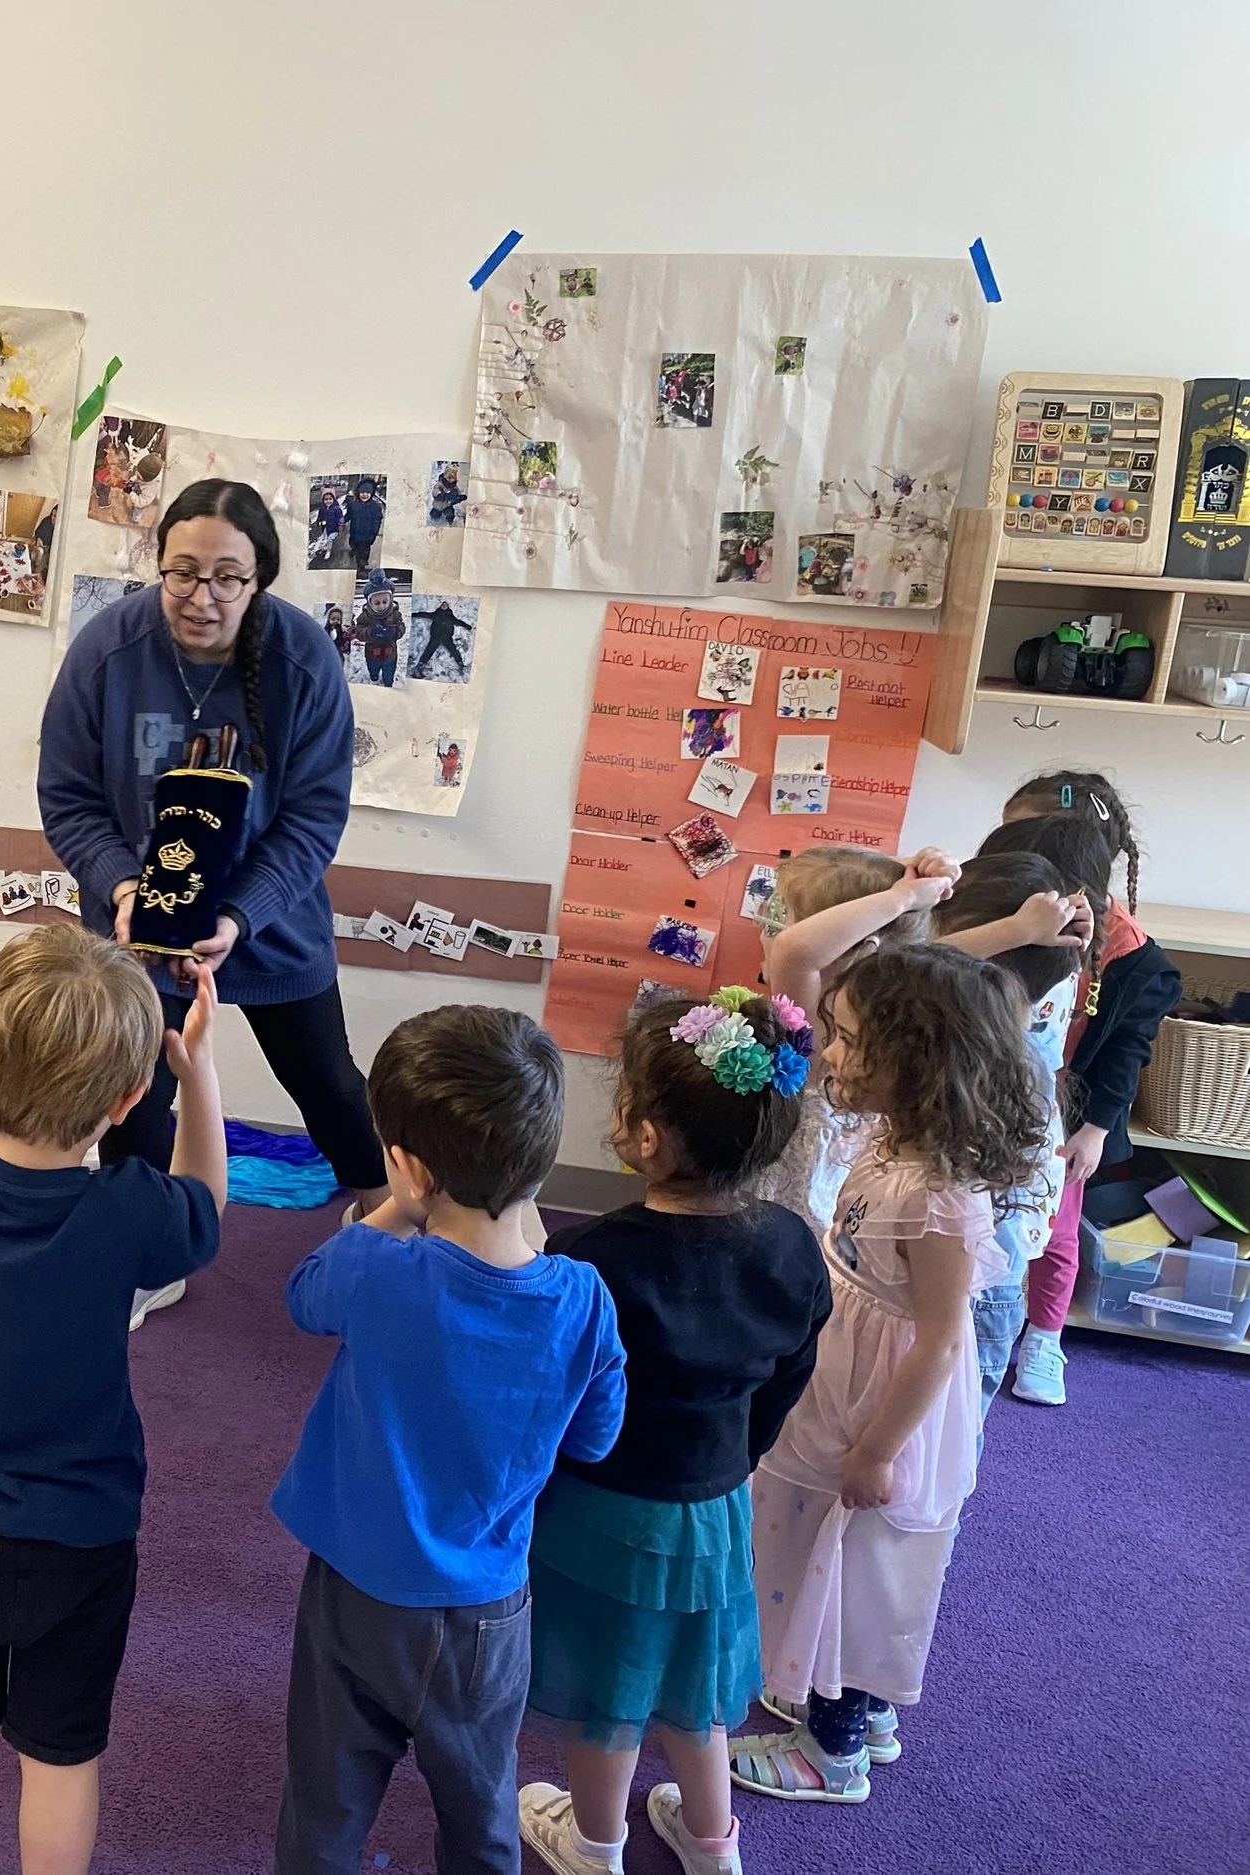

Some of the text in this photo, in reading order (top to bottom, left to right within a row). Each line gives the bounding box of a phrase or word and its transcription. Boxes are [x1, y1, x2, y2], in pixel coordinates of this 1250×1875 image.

[1046, 404, 1059, 418] B
[1094, 405, 1106, 417] D
[1018, 447, 1035, 461] M
[1136, 455, 1150, 468] R
[1133, 478, 1149, 491] X
[1054, 497, 1067, 509] Y
[717, 615, 818, 655] Classroom
[824, 629, 890, 662] Jobs
[708, 641, 744, 655] DAVID
[602, 648, 690, 674] Line Leader
[869, 694, 911, 709] Helper
[592, 701, 683, 722] Water bottle Hel
[583, 750, 678, 775] Sweeping Helper
[711, 759, 739, 774] MATAN
[880, 779, 911, 798] Helper
[626, 807, 662, 829] Helper
[811, 826, 885, 848] Chair Helper
[569, 855, 633, 872] Door Holder
[562, 902, 626, 921] Door Holder
[1131, 1293, 1162, 1307] Colorful
[1163, 1302, 1186, 1311] wood
